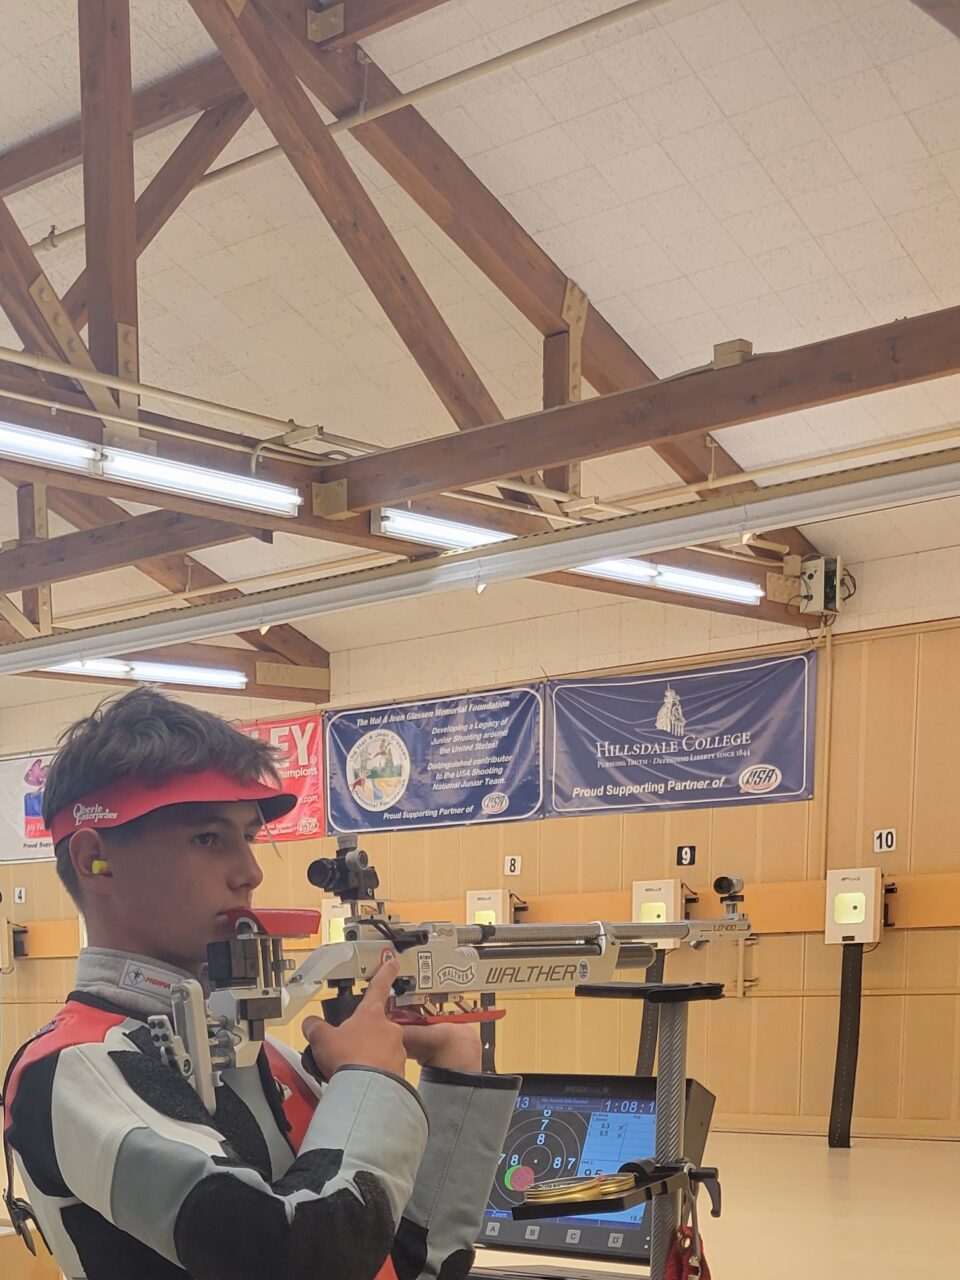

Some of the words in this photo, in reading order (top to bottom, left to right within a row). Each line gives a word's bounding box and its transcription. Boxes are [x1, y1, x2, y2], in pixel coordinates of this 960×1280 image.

[356, 719, 368, 728] The
[370, 716, 381, 726] Hal
[389, 713, 405, 723] Jean
[407, 711, 433, 721] Glassen
[435, 706, 467, 717] Memorial
[468, 700, 510, 713] Foundation
[432, 724, 468, 735] Developing
[475, 720, 499, 731] Legacy
[500, 718, 509, 726] of
[431, 736, 452, 746] Junior
[453, 733, 482, 744] Shooting
[483, 729, 509, 740] around
[440, 745, 451, 754] the
[452, 742, 473, 753] United
[596, 741, 679, 759] HILLSDALE
[682, 731, 751, 752] COLLEGE
[716, 751, 735, 759] SINCE
[736, 748, 751, 758] 1844
[427, 759, 472, 770] Distinguished
[473, 755, 514, 766] contributor
[436, 772, 442, 780] to
[444, 771, 455, 779] the
[456, 769, 470, 778] USA
[472, 766, 504, 777] Shooting
[432, 780, 460, 791] National
[461, 779, 483, 788] Junior
[572, 785, 605, 798] Proud
[606, 781, 665, 797] Supporting
[667, 778, 711, 792] Partner
[712, 776, 726, 789] of
[383, 810, 401, 820] Proud
[402, 808, 438, 819] Supporting
[439, 806, 465, 816] Partner
[465, 804, 475, 813] of
[39, 841, 54, 849] Supp
[876, 831, 894, 850] 10
[681, 846, 691, 865] 9
[509, 857, 517, 873] 8
[16, 889, 23, 902] 4
[442, 969, 469, 982] WALTHER
[485, 964, 578, 985] WALTHER
[605, 1100, 656, 1113] 1:08:1
[541, 1119, 549, 1132] 7
[536, 1133, 545, 1146] 8
[510, 1154, 519, 1166] 8
[553, 1156, 562, 1169] 8
[567, 1157, 576, 1170] 7
